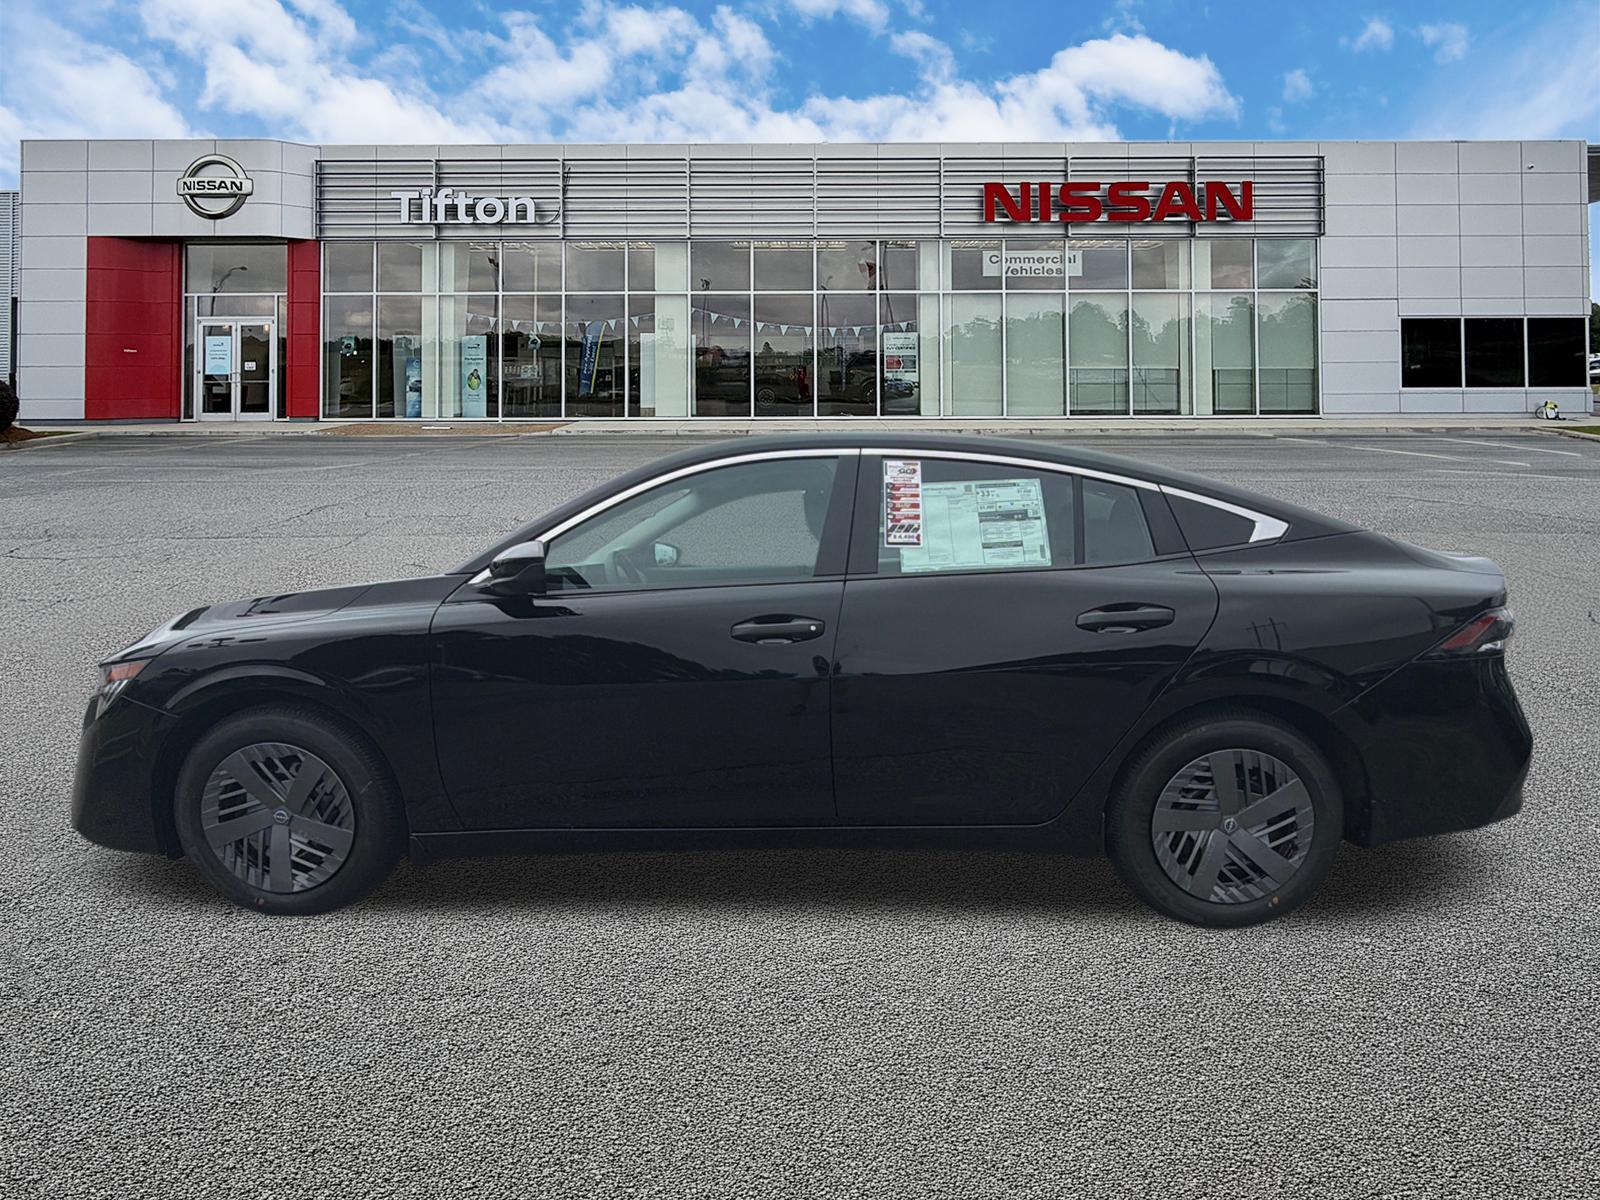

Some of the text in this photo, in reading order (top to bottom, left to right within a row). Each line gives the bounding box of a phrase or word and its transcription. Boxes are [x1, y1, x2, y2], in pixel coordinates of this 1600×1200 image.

[182, 180, 243, 192] NISSAN
[983, 181, 1253, 222] NISSAN
[391, 188, 536, 224] Tifton
